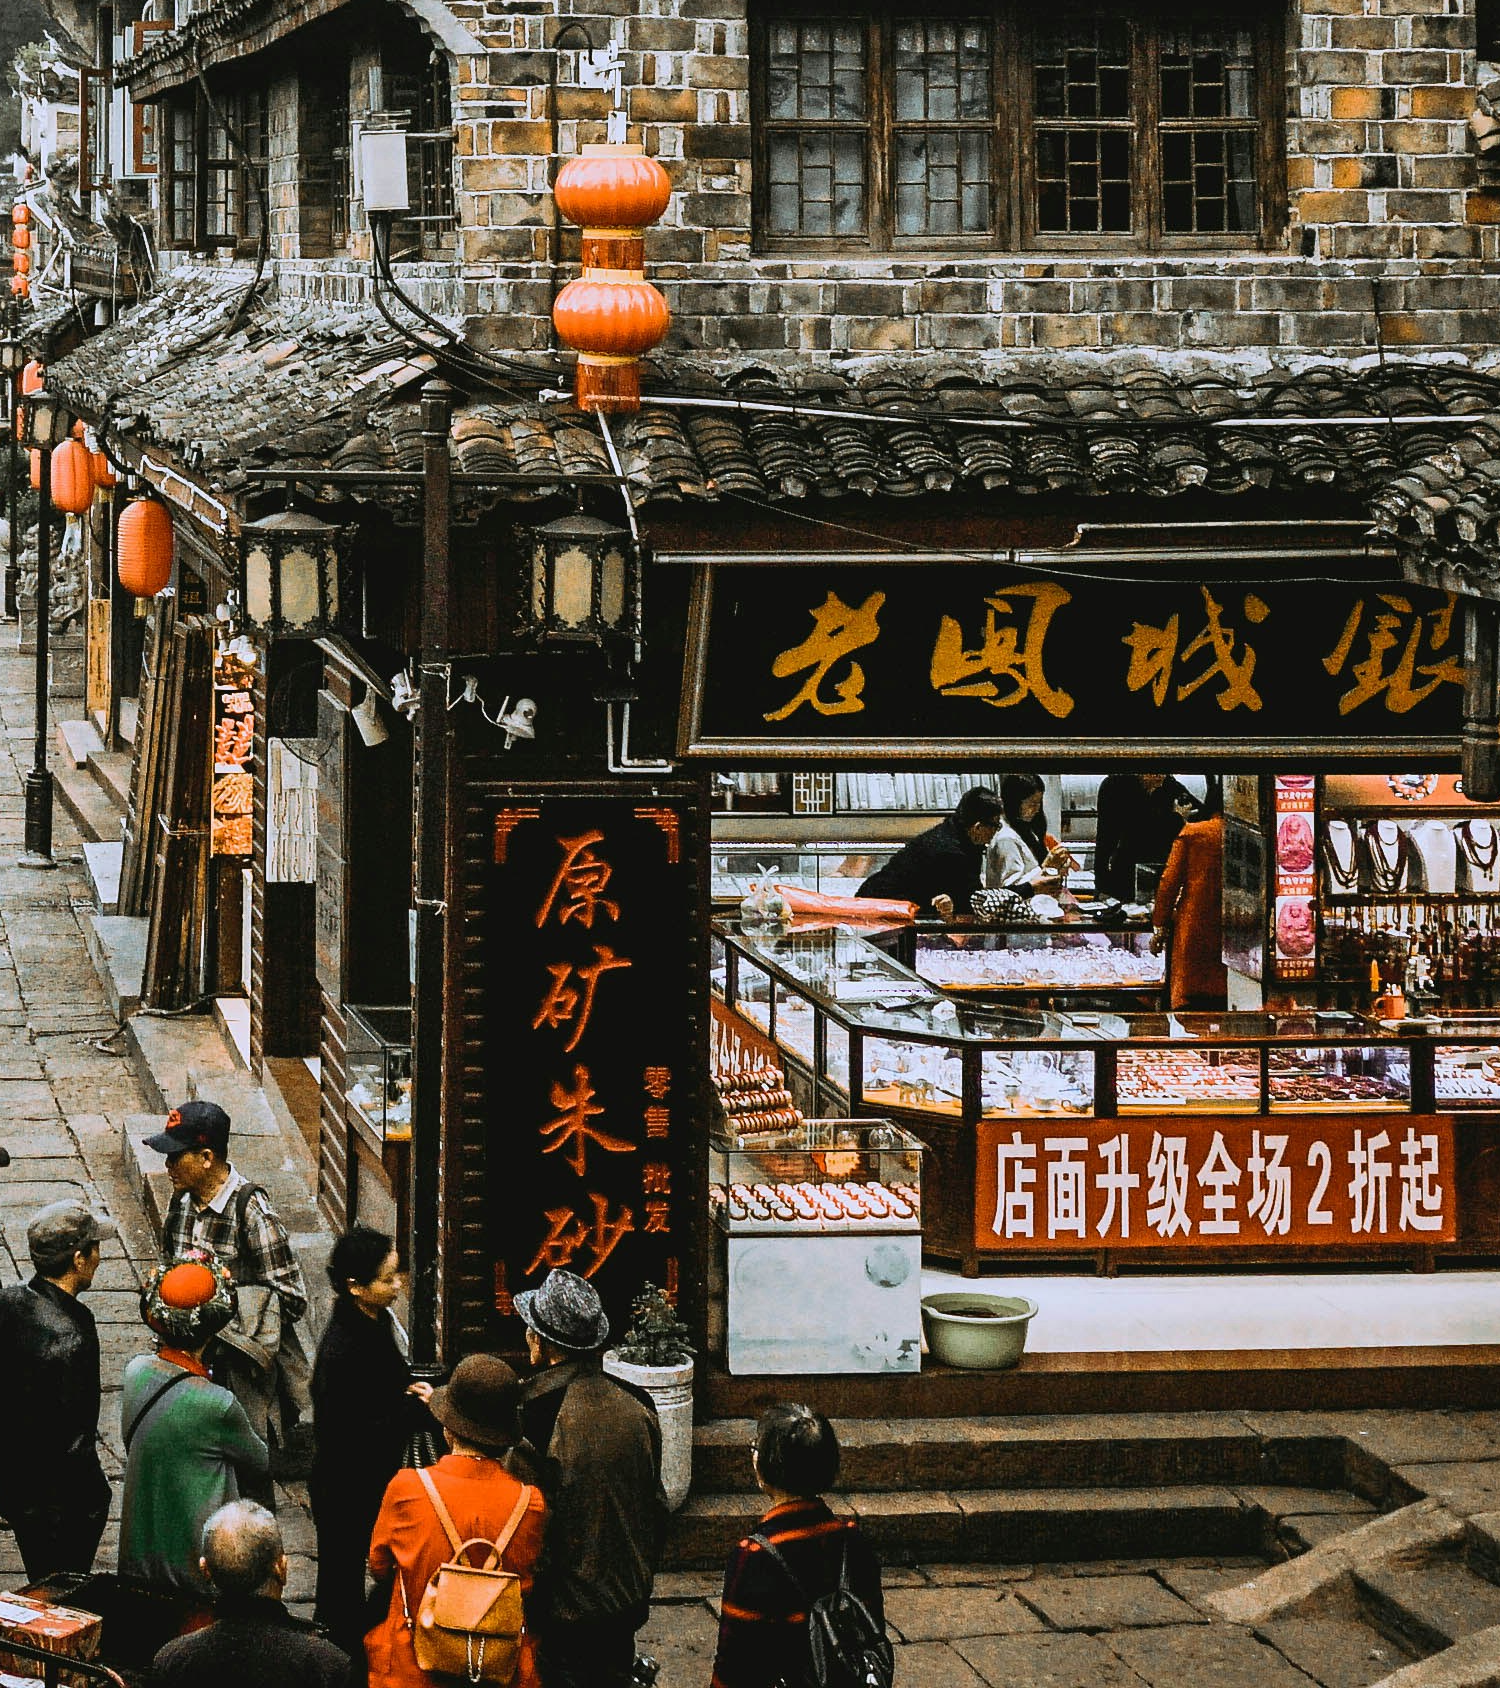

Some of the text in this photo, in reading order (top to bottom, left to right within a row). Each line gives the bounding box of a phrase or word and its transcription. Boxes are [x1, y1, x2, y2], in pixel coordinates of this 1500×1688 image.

[525, 829, 637, 1280] 原矿朱砂
[992, 1127, 1443, 1239] 店面升级全场2折起
